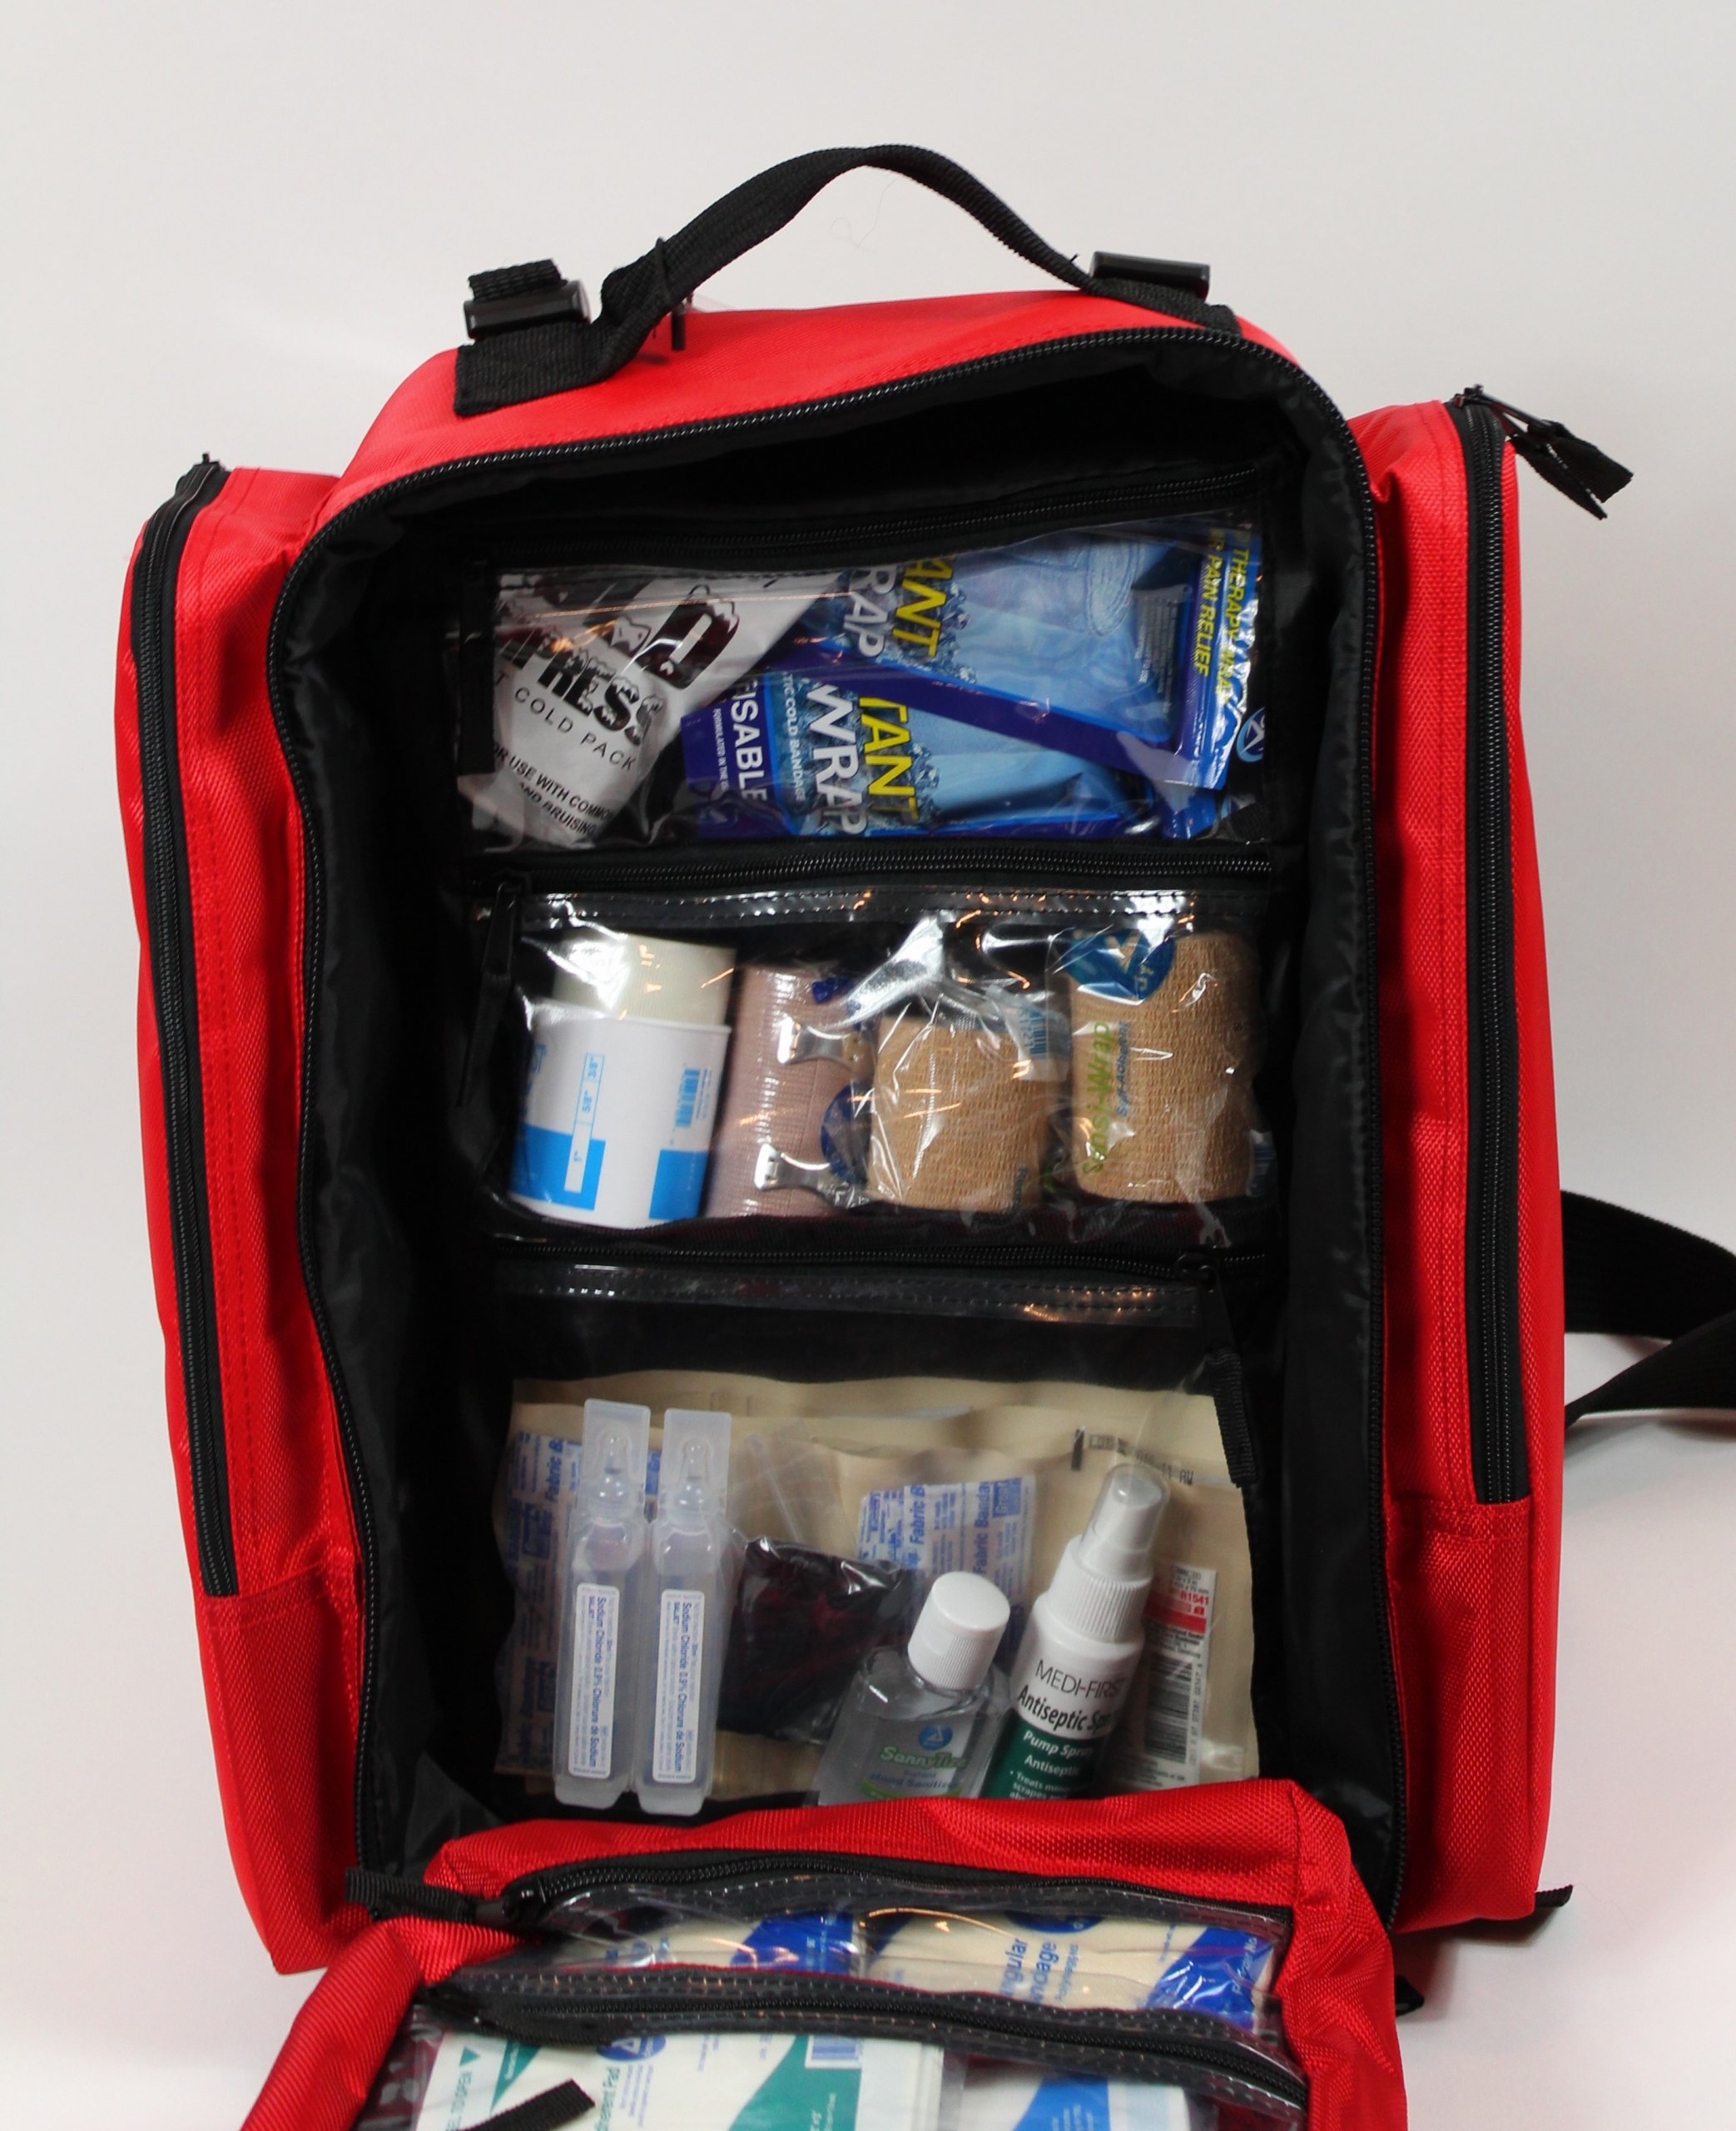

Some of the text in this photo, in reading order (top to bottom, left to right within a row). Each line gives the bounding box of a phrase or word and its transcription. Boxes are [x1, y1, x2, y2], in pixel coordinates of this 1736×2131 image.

[1202, 554, 1223, 601] PAIN
[1225, 548, 1250, 641] THERAPY
[1194, 604, 1217, 677] RELIEF
[514, 687, 637, 772] COLD PACK
[785, 697, 798, 736] COLD
[790, 738, 806, 802] BANDAGE
[806, 683, 868, 835] WRAP
[509, 754, 537, 781] USE
[536, 773, 569, 802] WITH
[910, 1501, 926, 1545] Fabric
[972, 1532, 990, 1575] Fabric
[597, 1597, 606, 1627] Sodium
[682, 1602, 692, 1633] Sodium
[594, 1630, 605, 1663] Chloride
[680, 1635, 690, 1668] Chloride
[1035, 1660, 1123, 1699] MEDI-FIRS
[592, 1687, 602, 1722] Chlorure
[677, 1693, 687, 1728] Chlorure
[1018, 1685, 1088, 1731] Antiseptic
[591, 1726, 598, 1735] de
[676, 1731, 683, 1740] de
[1023, 1730, 1059, 1755] Pump
[589, 1737, 599, 1767] Sodium
[675, 1742, 685, 1771] Sodium
[1024, 1755, 1081, 1777] Antiseptic
